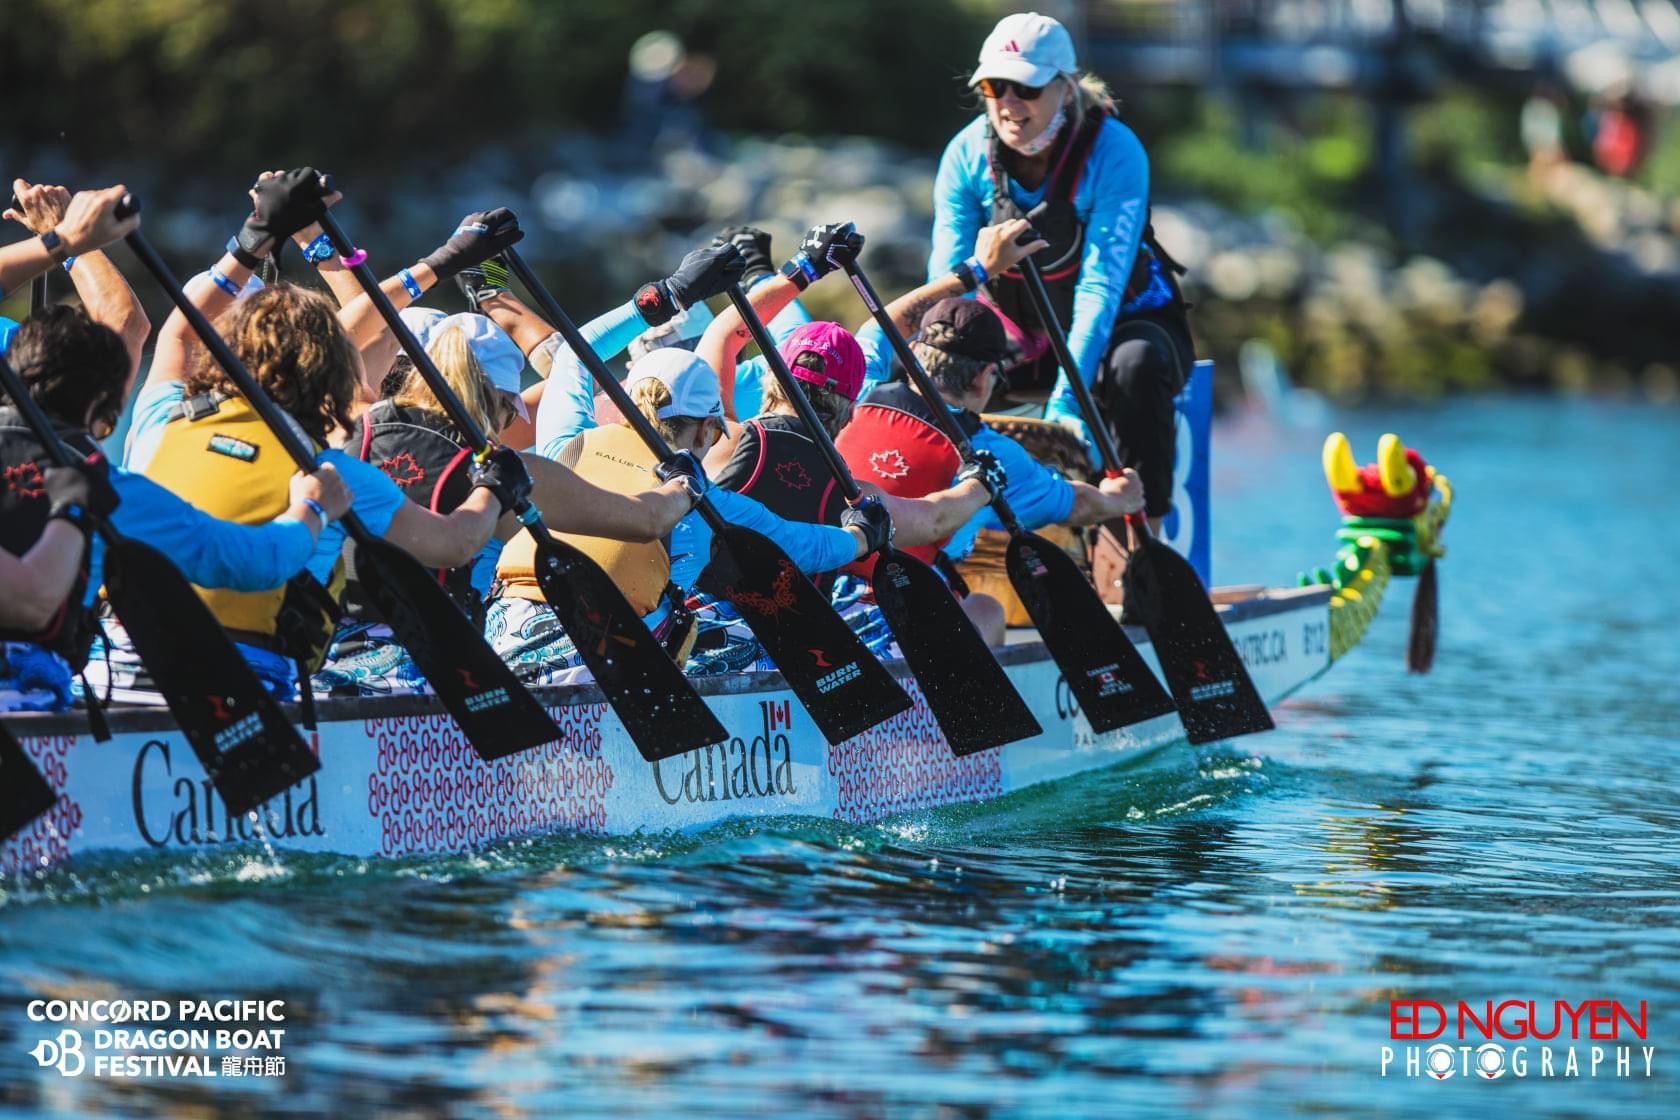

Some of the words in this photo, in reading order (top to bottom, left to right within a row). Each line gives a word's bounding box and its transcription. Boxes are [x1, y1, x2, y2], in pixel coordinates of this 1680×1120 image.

[816, 661, 858, 688] BURN
[819, 669, 862, 694] WATER
[464, 687, 506, 706] BURN
[468, 695, 510, 712] WATER
